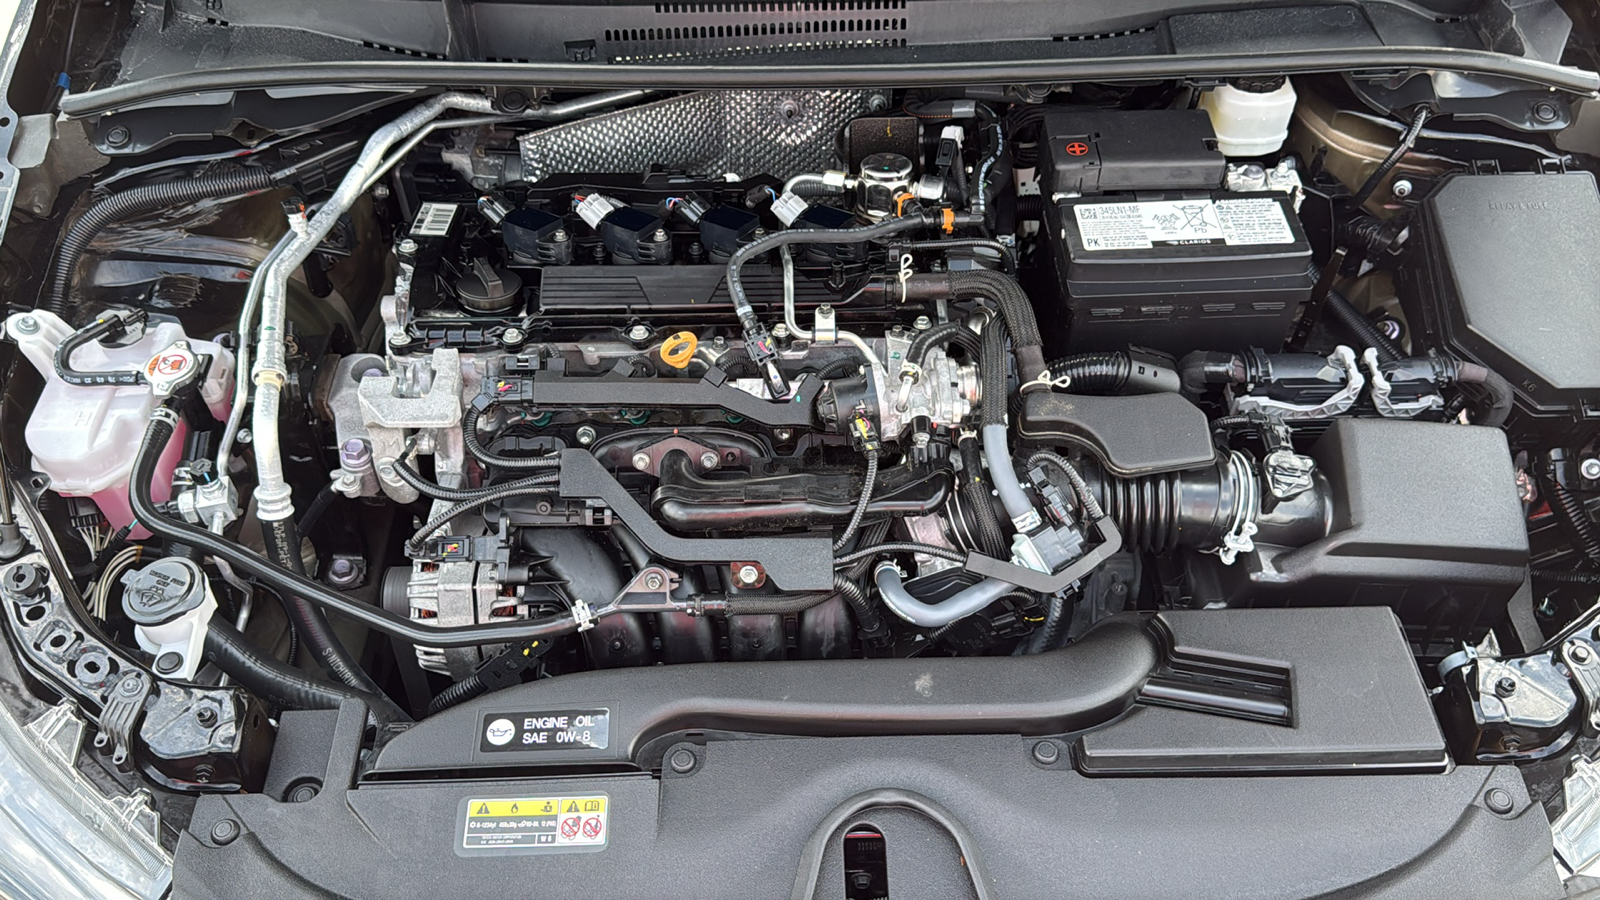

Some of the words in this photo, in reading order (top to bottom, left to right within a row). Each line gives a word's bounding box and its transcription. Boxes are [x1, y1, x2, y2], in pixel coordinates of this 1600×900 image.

[1087, 238, 1100, 247] PK
[523, 717, 568, 729] ENGINE
[575, 716, 595, 727] OIL
[522, 732, 548, 744] SAE
[556, 731, 591, 743] 0W-8
